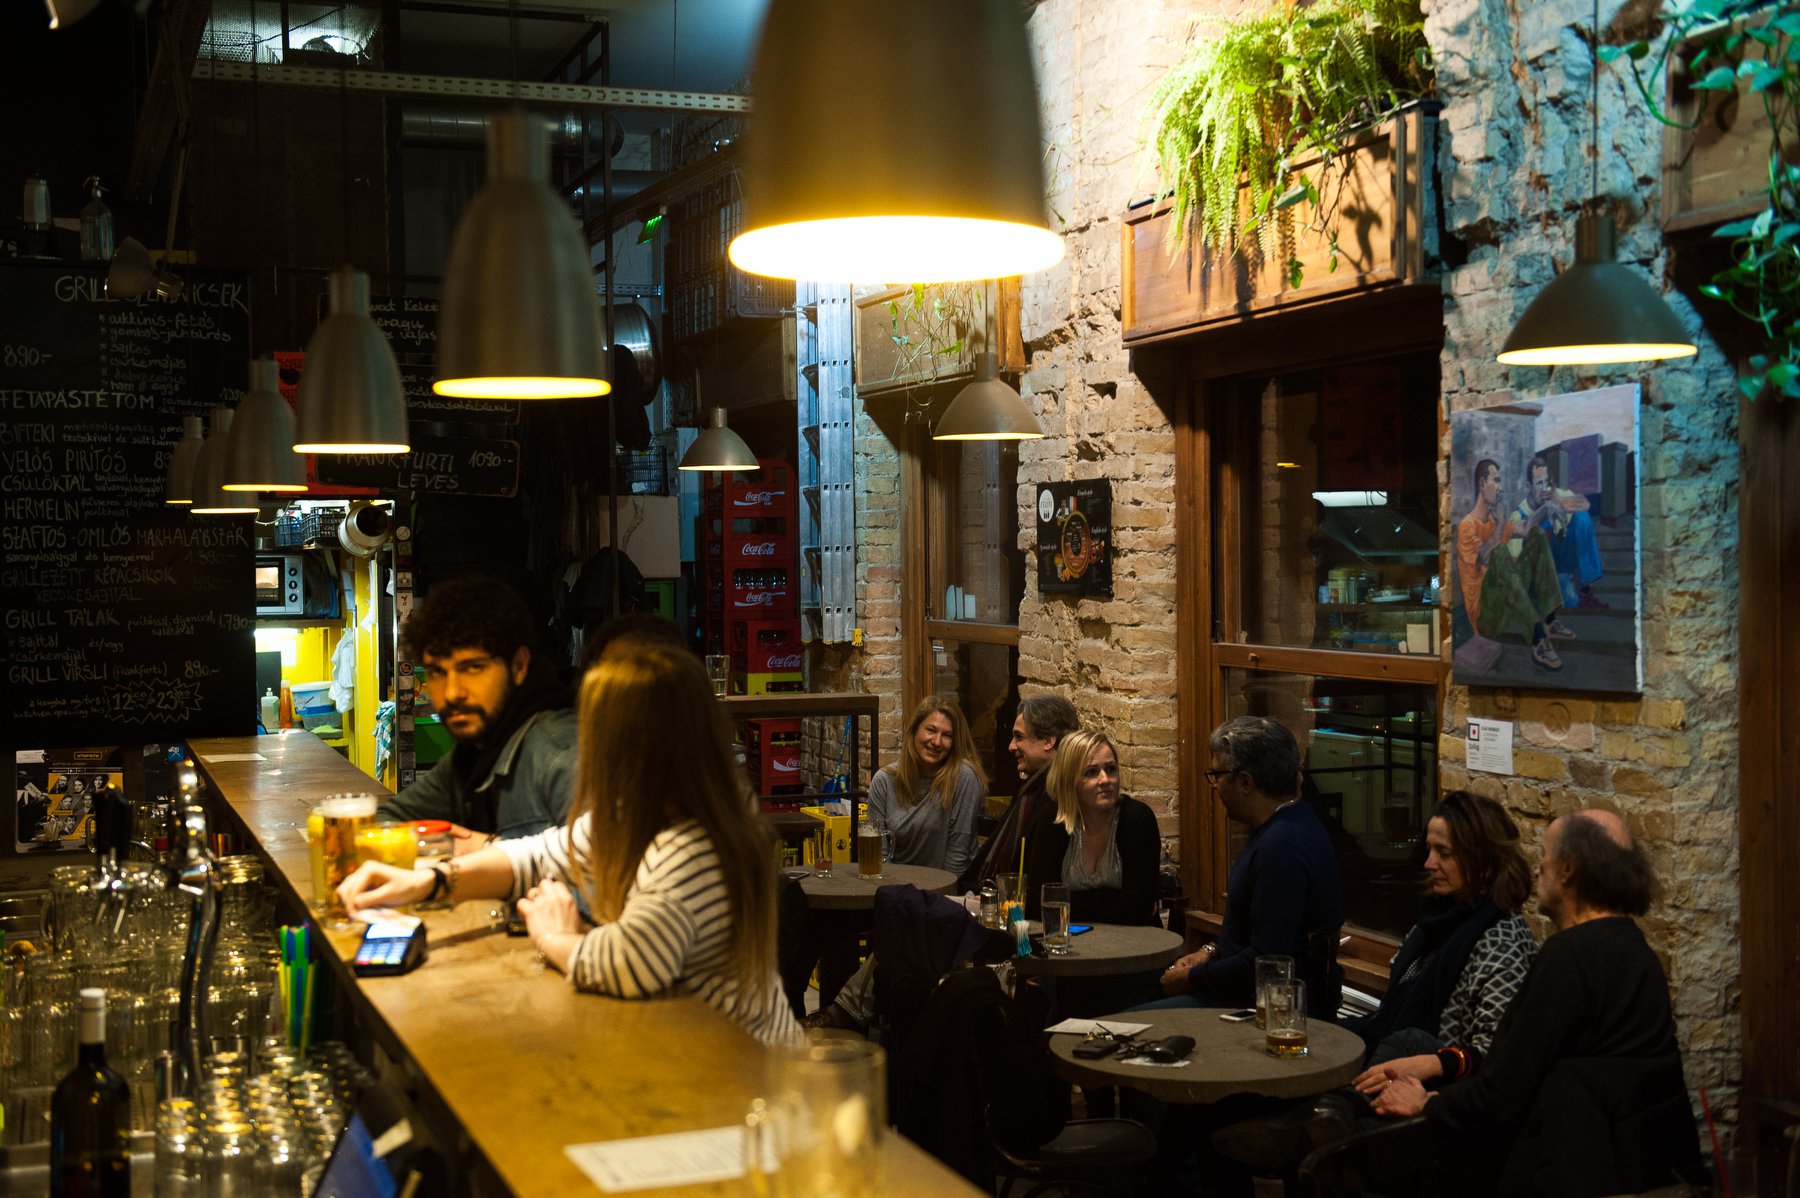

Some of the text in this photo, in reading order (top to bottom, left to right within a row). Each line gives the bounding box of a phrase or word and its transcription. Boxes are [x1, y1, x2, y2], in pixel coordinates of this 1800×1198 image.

[397, 473, 460, 491] LEVES
[4, 496, 80, 521] HERMELIN
[5, 608, 57, 629] GRILL
[64, 607, 120, 627] TÁLAK
[9, 665, 59, 685] GRILL
[62, 662, 107, 681] VIRSLI
